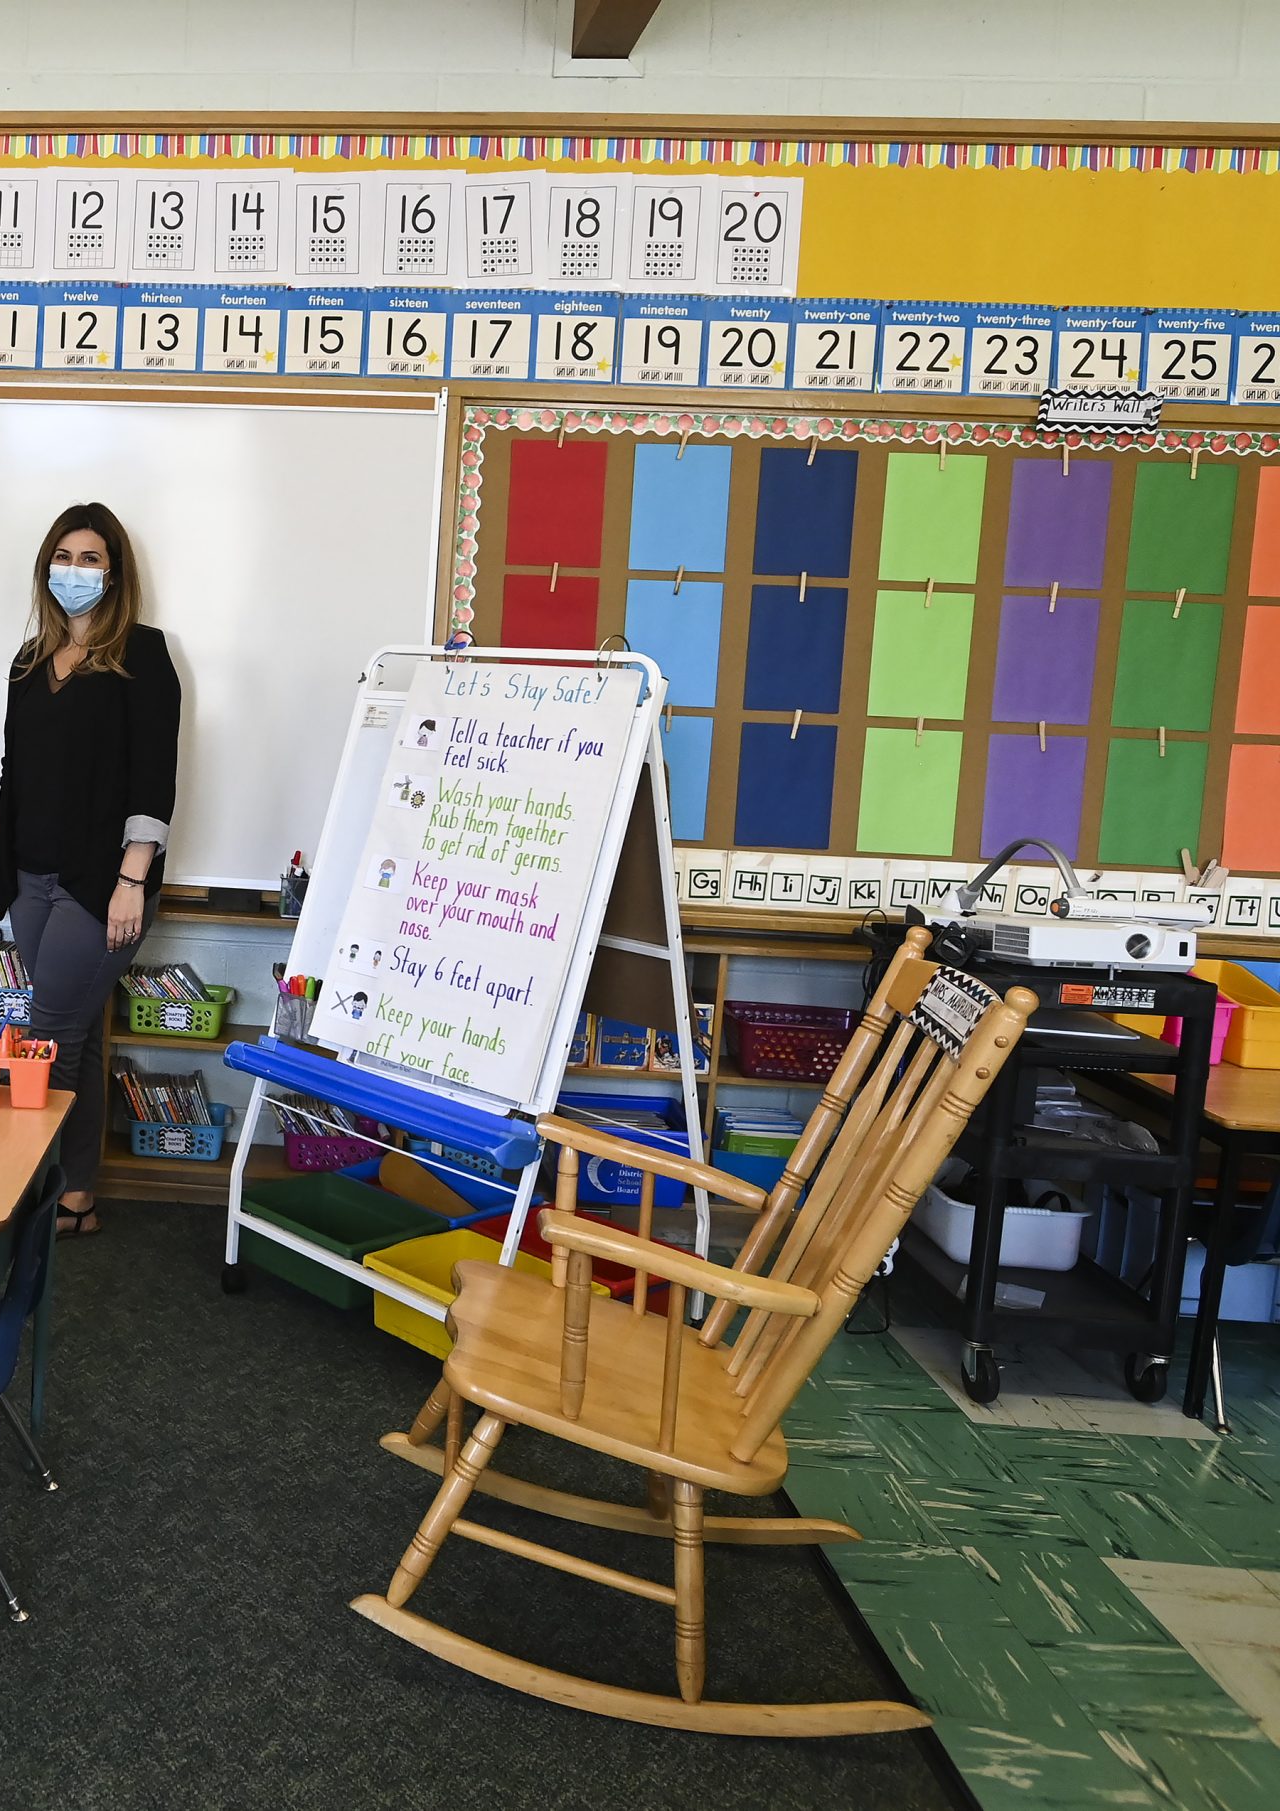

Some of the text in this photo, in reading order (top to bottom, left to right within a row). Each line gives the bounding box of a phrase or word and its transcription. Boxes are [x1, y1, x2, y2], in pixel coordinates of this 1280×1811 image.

[72, 192, 103, 228] 12
[565, 198, 599, 237] 18
[724, 202, 781, 243] 20
[63, 290, 99, 302] twelve
[140, 292, 182, 304] thirteen
[308, 295, 344, 307] fifteen
[465, 298, 521, 311] seventeen
[640, 305, 688, 317] nineteen
[804, 309, 871, 322] twenty-one
[976, 313, 1051, 328] twenty-three
[1065, 315, 1137, 330] twenty-four
[1157, 318, 1226, 332] twenty-five
[644, 325, 680, 365] 19
[1162, 340, 1216, 380] 25
[1113, 399, 1141, 413] Wall
[445, 670, 609, 711] Let's Stay Safe!
[450, 717, 604, 762] Tell a teacher if you
[444, 745, 509, 774] feel sick.
[439, 776, 576, 822] Wash your hands.
[429, 803, 568, 848] Rub them together
[422, 828, 563, 876] to get rid of germs.
[412, 860, 539, 910] Keep your mask
[693, 872, 718, 895] Gg
[738, 873, 762, 892] Hh
[782, 875, 793, 893] Ii
[813, 878, 837, 902] Jj
[853, 882, 876, 900] Kk
[900, 883, 917, 899] Ll
[1019, 889, 1047, 908] Oo
[1236, 899, 1256, 917] Tt
[406, 896, 560, 942] over your mouth and
[399, 919, 432, 941] nose.
[390, 945, 533, 1009] Stay 6 feet apart.
[375, 992, 506, 1056] Keep your hands
[365, 1033, 395, 1056] off
[400, 1050, 434, 1071] your
[441, 1052, 474, 1084] face.
[617, 1178, 642, 1186] School
[619, 1169, 643, 1178] Distric
[617, 1186, 640, 1195] Board
